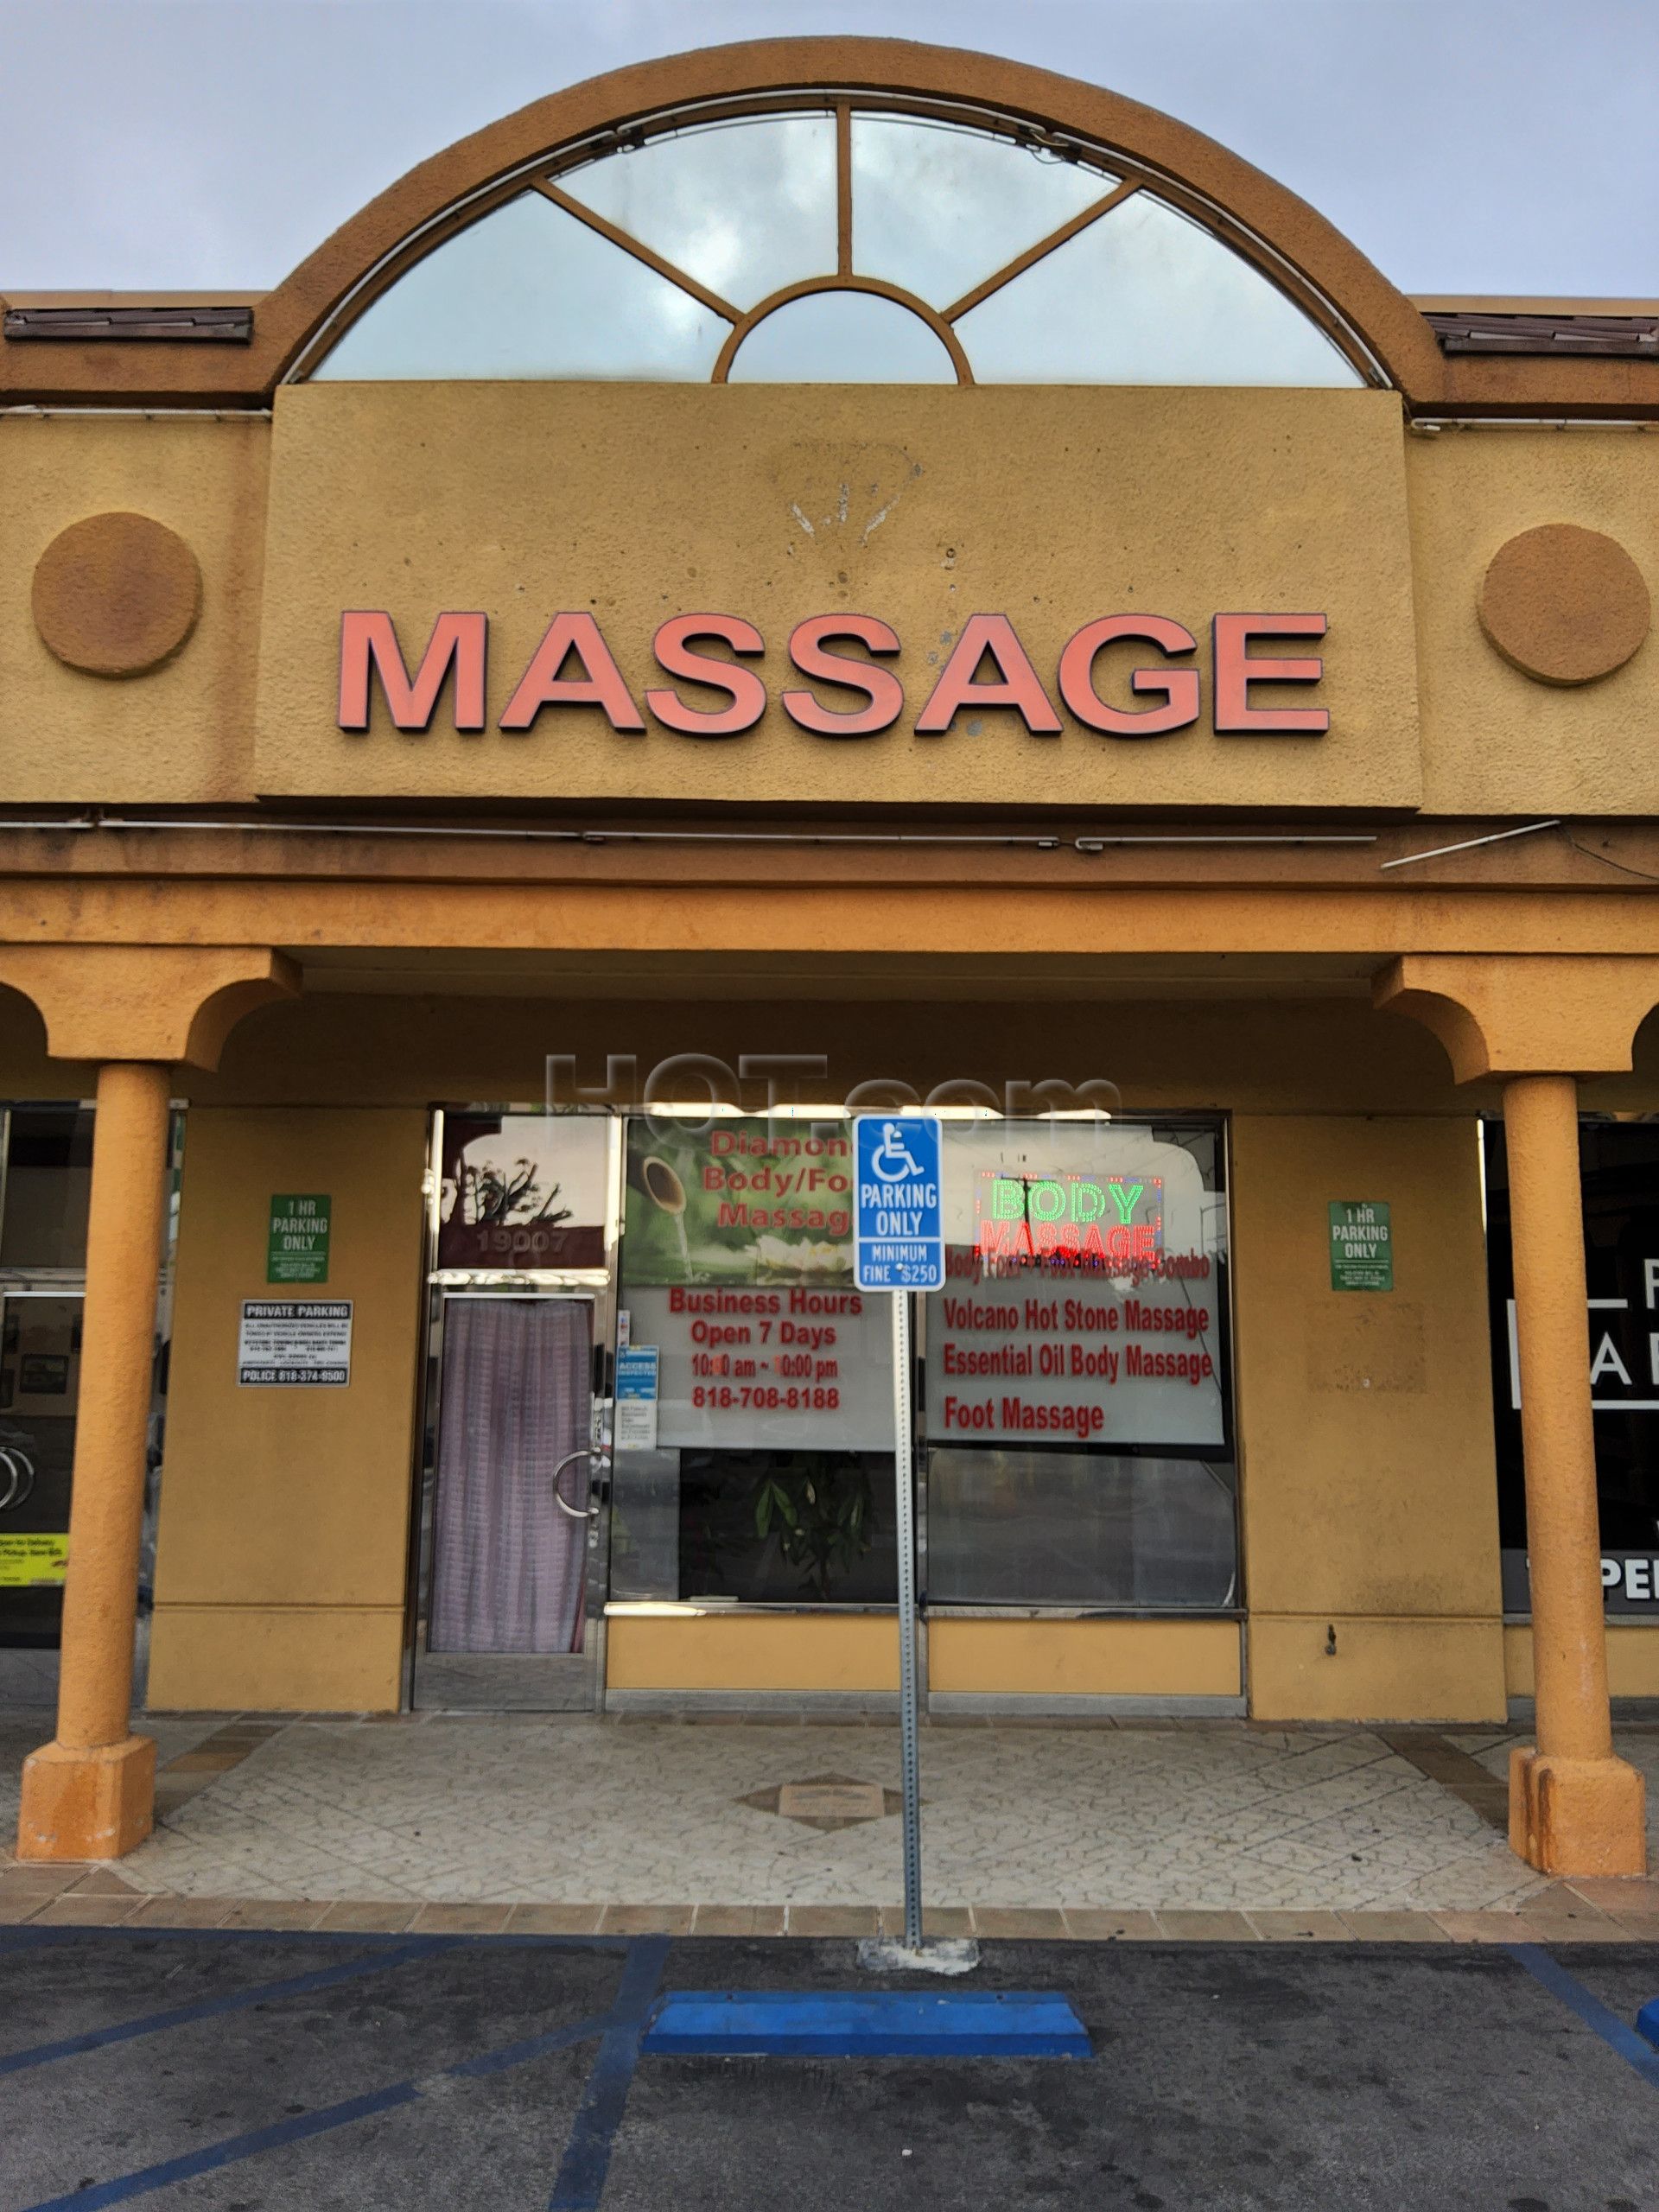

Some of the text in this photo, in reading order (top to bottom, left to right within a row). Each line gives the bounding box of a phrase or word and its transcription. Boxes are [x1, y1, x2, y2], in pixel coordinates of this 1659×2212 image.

[338, 610, 1331, 737] MASSAGE
[711, 1130, 854, 1157] Diamon
[704, 1166, 854, 1198] Body/Fo
[289, 1199, 316, 1216] 1 HR
[861, 1183, 938, 1209] PARKING
[992, 1179, 1144, 1224] BODY
[272, 1217, 328, 1234] PARKING
[718, 1202, 855, 1236] Massag
[876, 1211, 923, 1236] ONLY
[1346, 1209, 1375, 1224] 1 HR
[283, 1235, 316, 1251] ONLY
[477, 1229, 569, 1252] 19007
[978, 1220, 1156, 1262] MASSAGE
[1332, 1225, 1389, 1241] PARKING
[871, 1245, 927, 1262] MINIMUM
[1344, 1243, 1377, 1259] ONLY
[864, 1264, 938, 1283] FINE $250
[246, 1305, 347, 1317] PRIVATE PARKING
[669, 1287, 863, 1315] Business Hours
[943, 1298, 1210, 1340] Volcano Hot Stone Massage
[691, 1319, 836, 1350] Open 7 Days
[243, 1369, 276, 1381] POLICE
[734, 1359, 756, 1377] am
[816, 1359, 838, 1382] pm
[943, 1343, 1212, 1386] Essential Oil Body Massage
[693, 1386, 839, 1409] 818-708-8188
[944, 1395, 1105, 1439] Foot Massage
